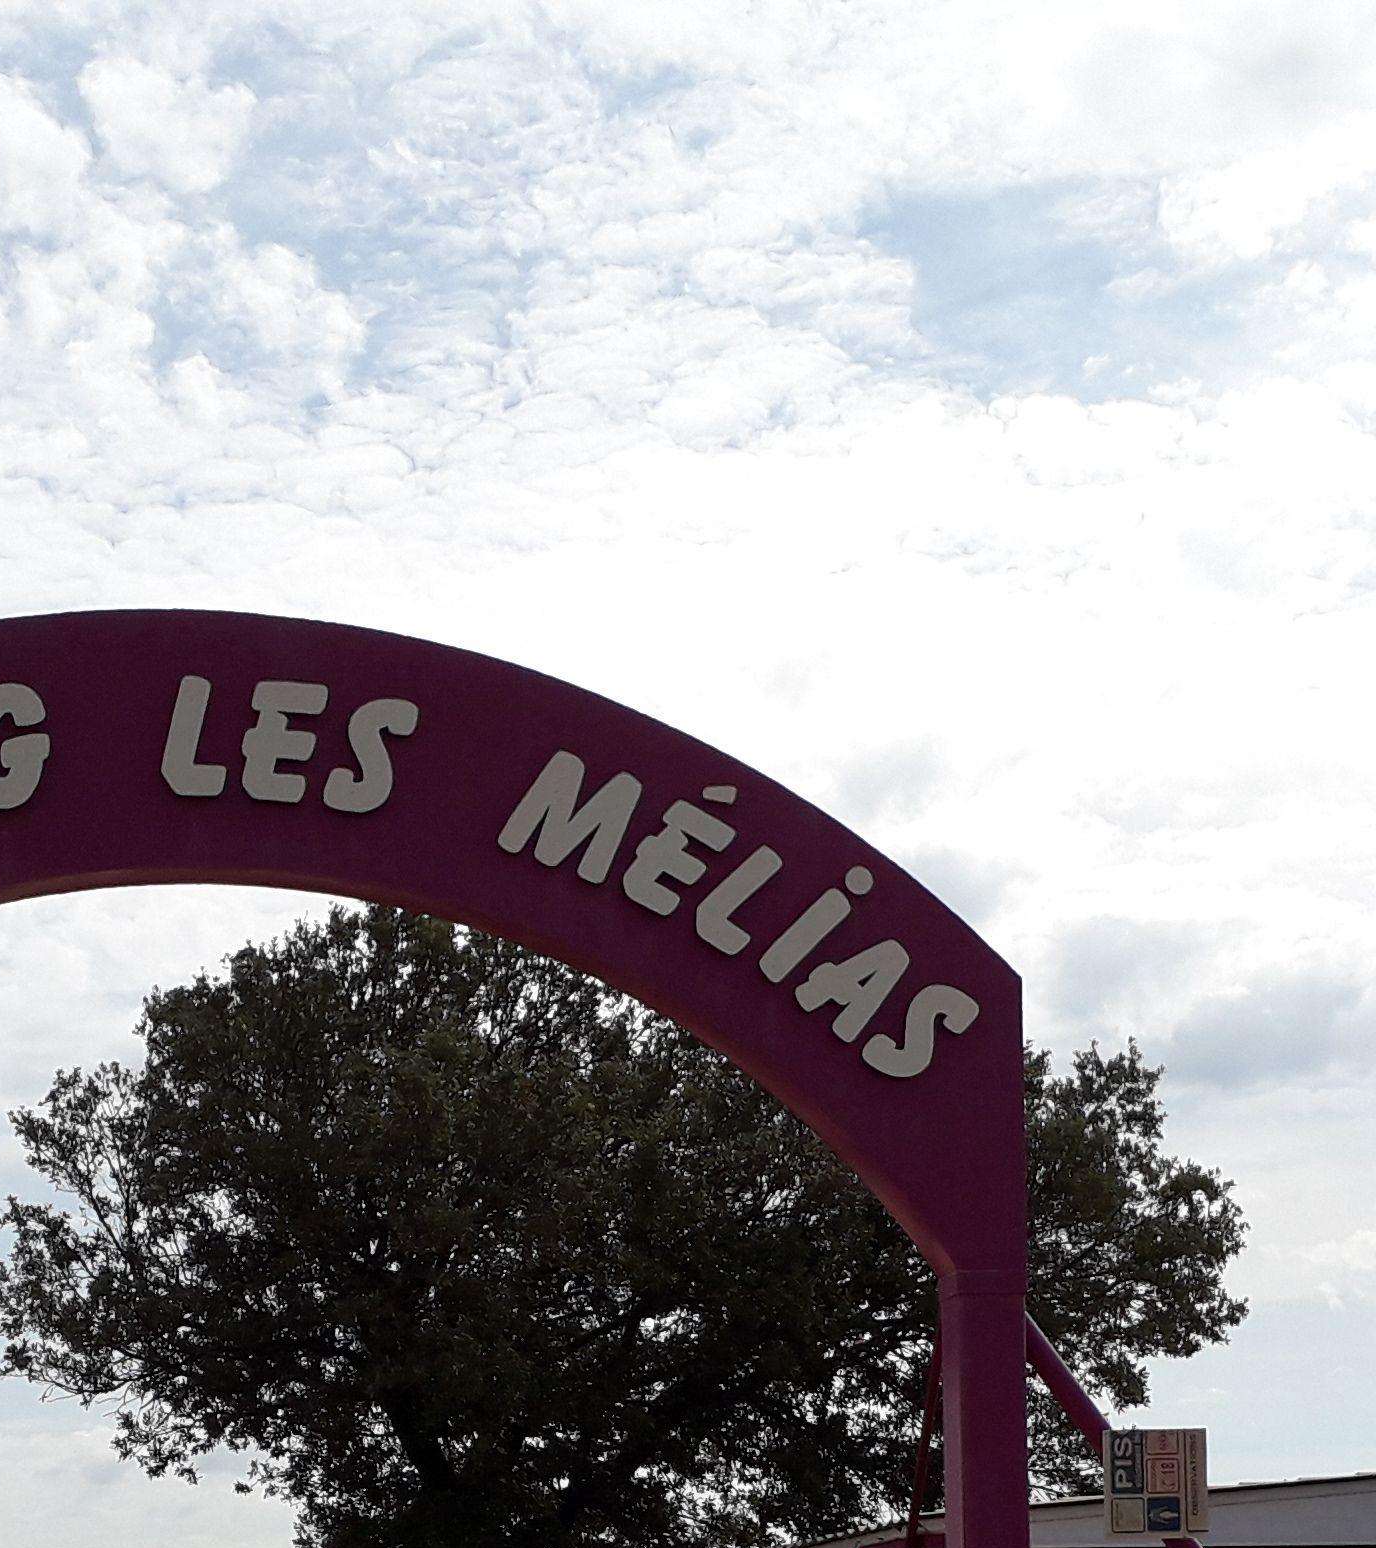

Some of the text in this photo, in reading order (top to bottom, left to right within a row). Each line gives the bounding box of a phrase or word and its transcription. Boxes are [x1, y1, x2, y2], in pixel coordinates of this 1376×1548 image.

[160, 674, 419, 813] LES
[497, 749, 980, 1078] MÉLIAS
[1113, 1430, 1133, 1488] PIS
